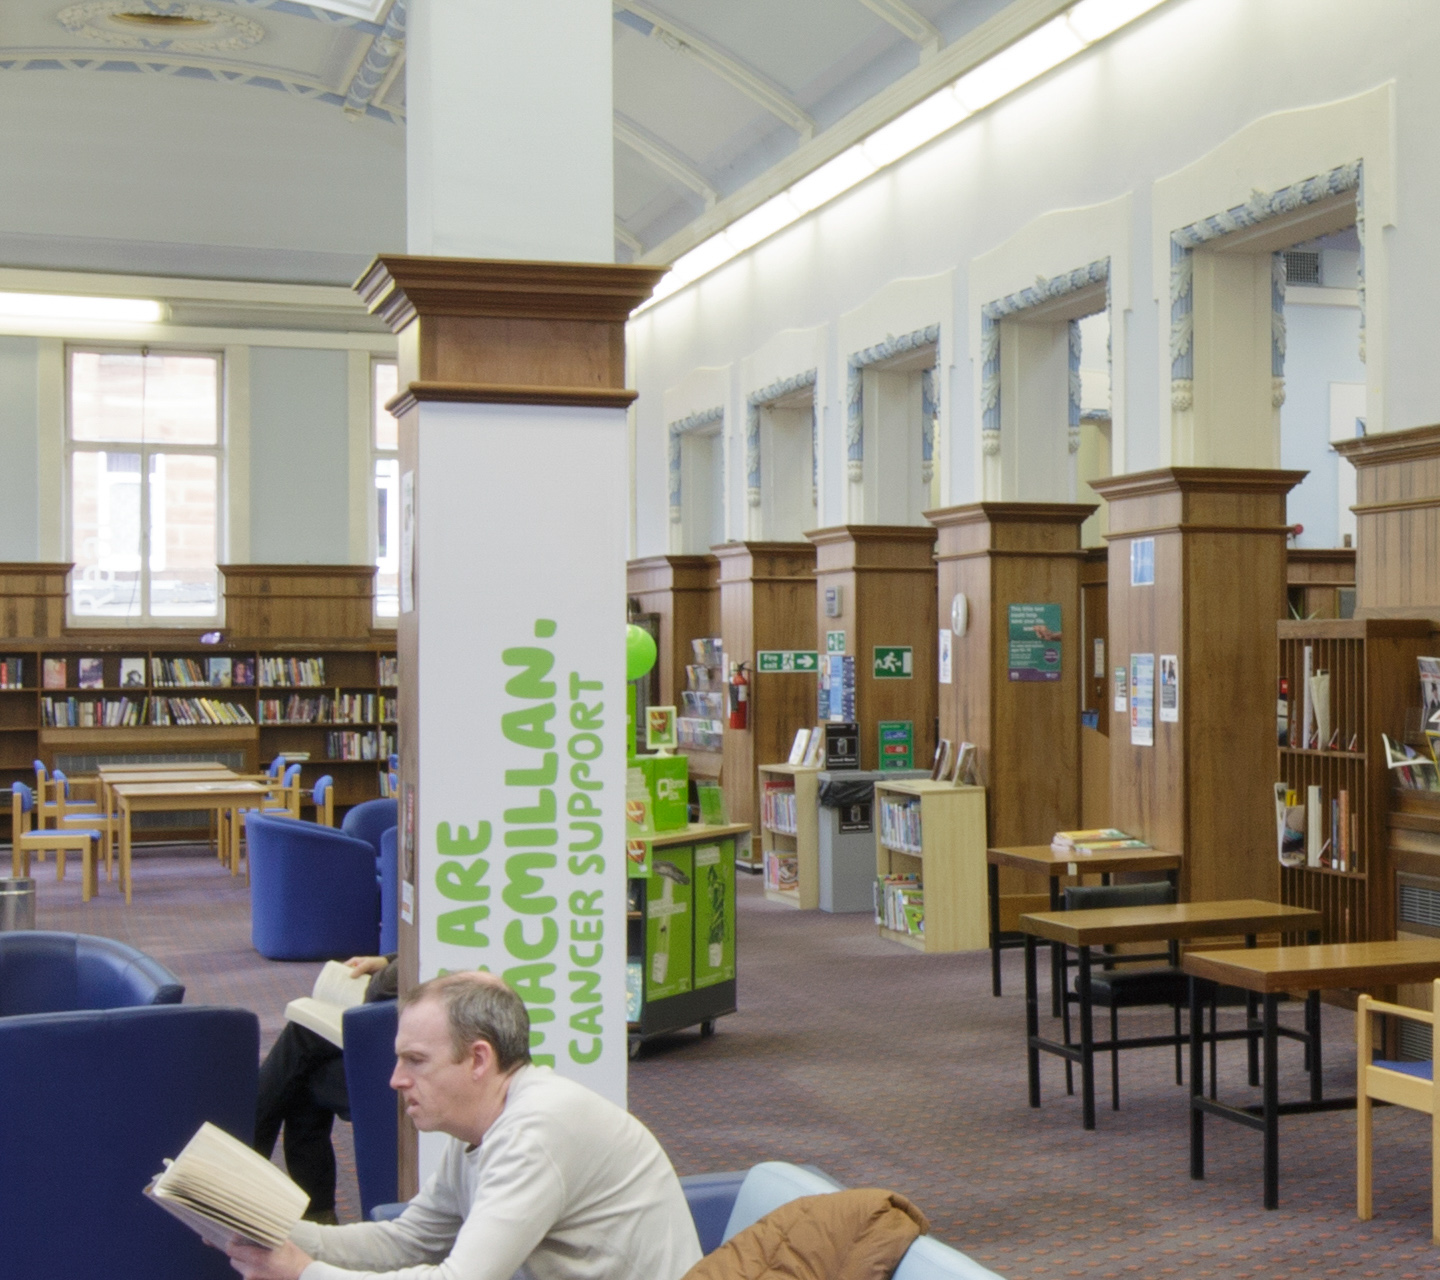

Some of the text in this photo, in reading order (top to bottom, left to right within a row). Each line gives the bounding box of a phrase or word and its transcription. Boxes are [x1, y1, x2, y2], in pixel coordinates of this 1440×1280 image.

[762, 654, 778, 662] Fire
[762, 661, 778, 669] exit
[435, 820, 492, 947] ARE
[568, 671, 604, 1065] CANCER SUPPORT
